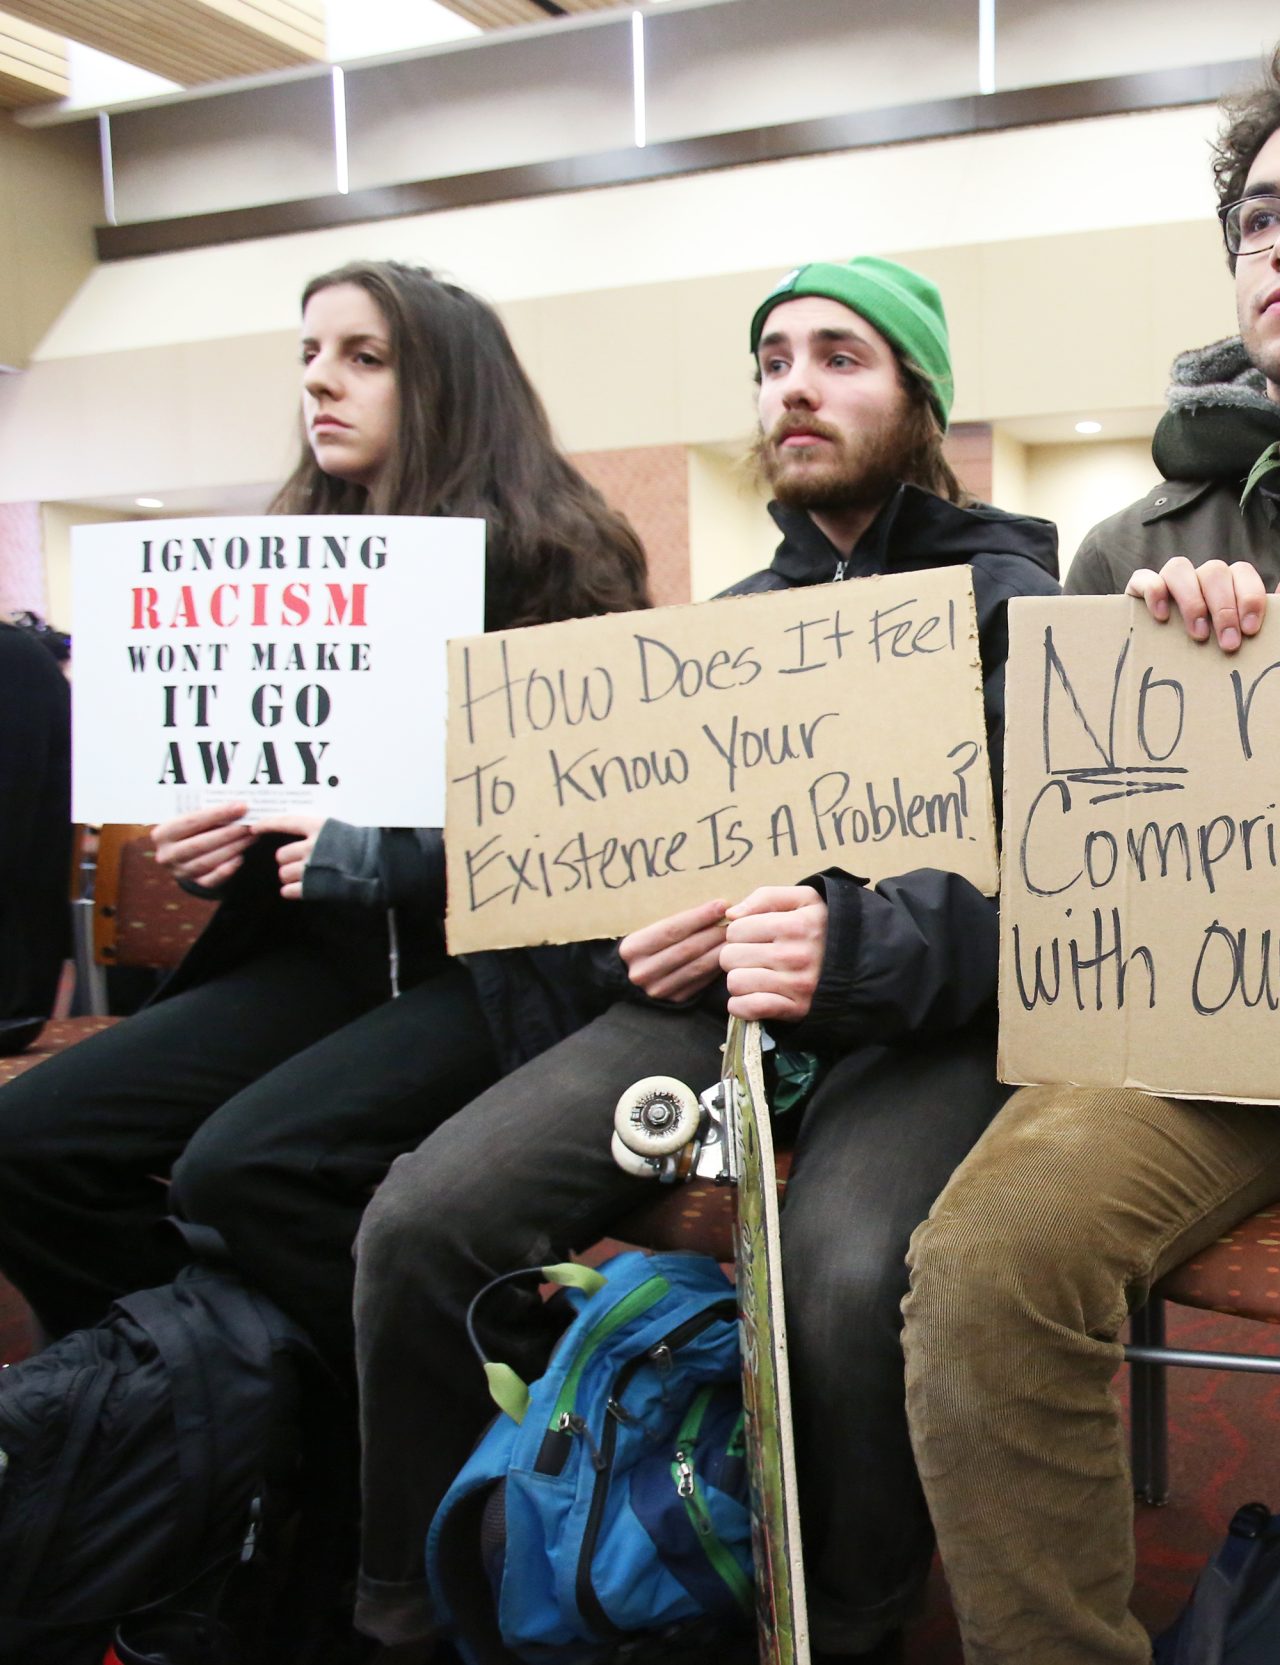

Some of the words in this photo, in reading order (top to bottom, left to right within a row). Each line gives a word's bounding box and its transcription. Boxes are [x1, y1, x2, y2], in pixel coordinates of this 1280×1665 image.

[141, 535, 388, 573] IGNORING
[130, 583, 369, 630] RACISM
[127, 643, 229, 673] WONT
[251, 642, 372, 671] MAKE
[460, 639, 614, 744] How
[633, 633, 762, 703] Does
[778, 610, 854, 674] It
[868, 598, 956, 663] Feel
[162, 685, 218, 728] IT
[250, 683, 331, 728] GO
[1044, 625, 1185, 774] No
[158, 741, 339, 787] AWAY.
[452, 755, 516, 827] To
[549, 746, 689, 807] Know
[702, 712, 840, 792] Your
[465, 831, 688, 912] Existence
[698, 804, 756, 870] Is
[766, 804, 800, 858] A
